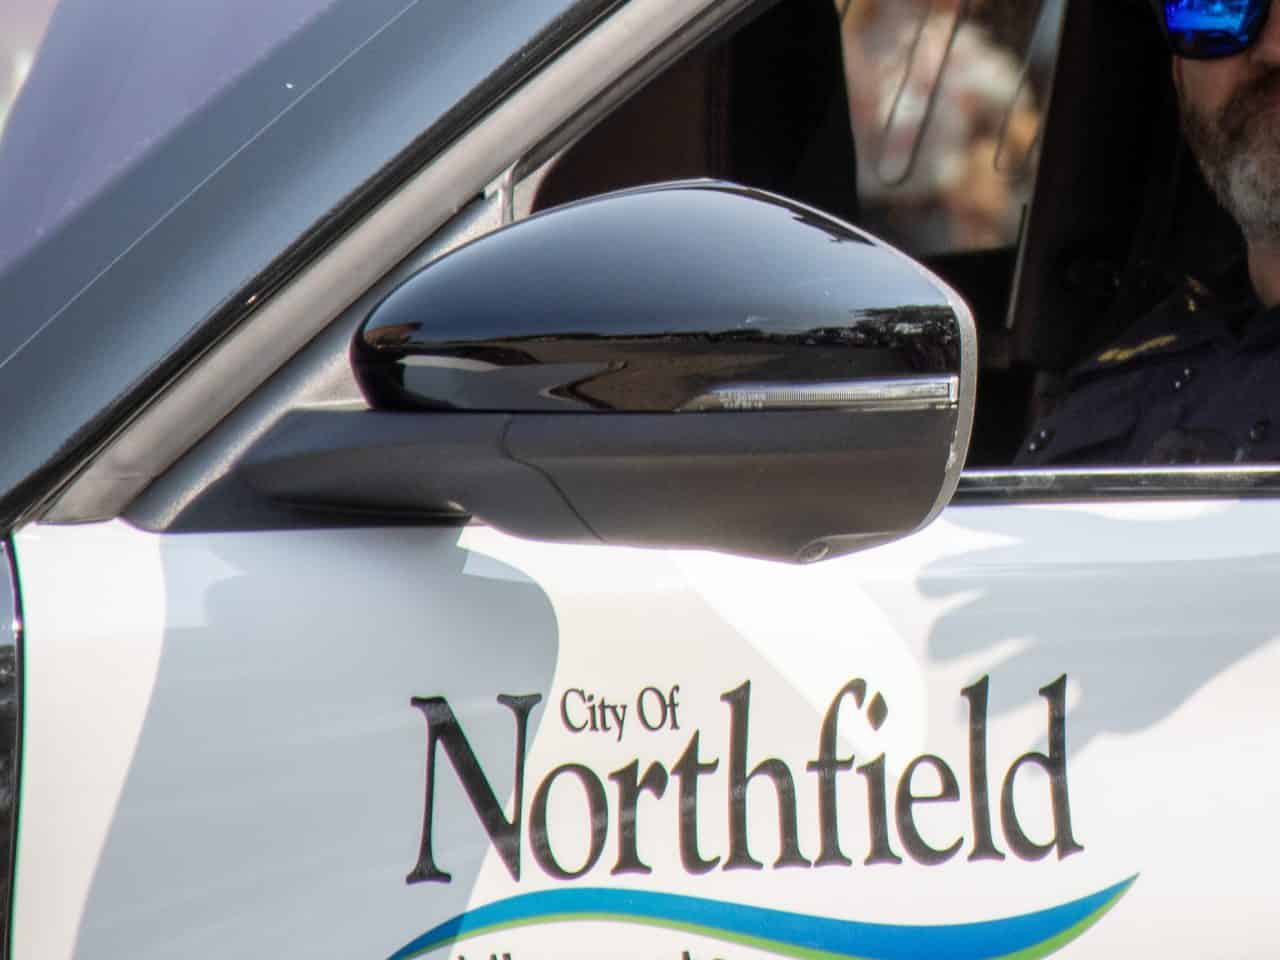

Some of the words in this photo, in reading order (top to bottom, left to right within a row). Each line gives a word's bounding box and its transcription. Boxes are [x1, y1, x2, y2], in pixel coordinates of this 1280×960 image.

[406, 674, 1084, 884] Northfield
[560, 688, 627, 742] City
[637, 683, 680, 731] Of
